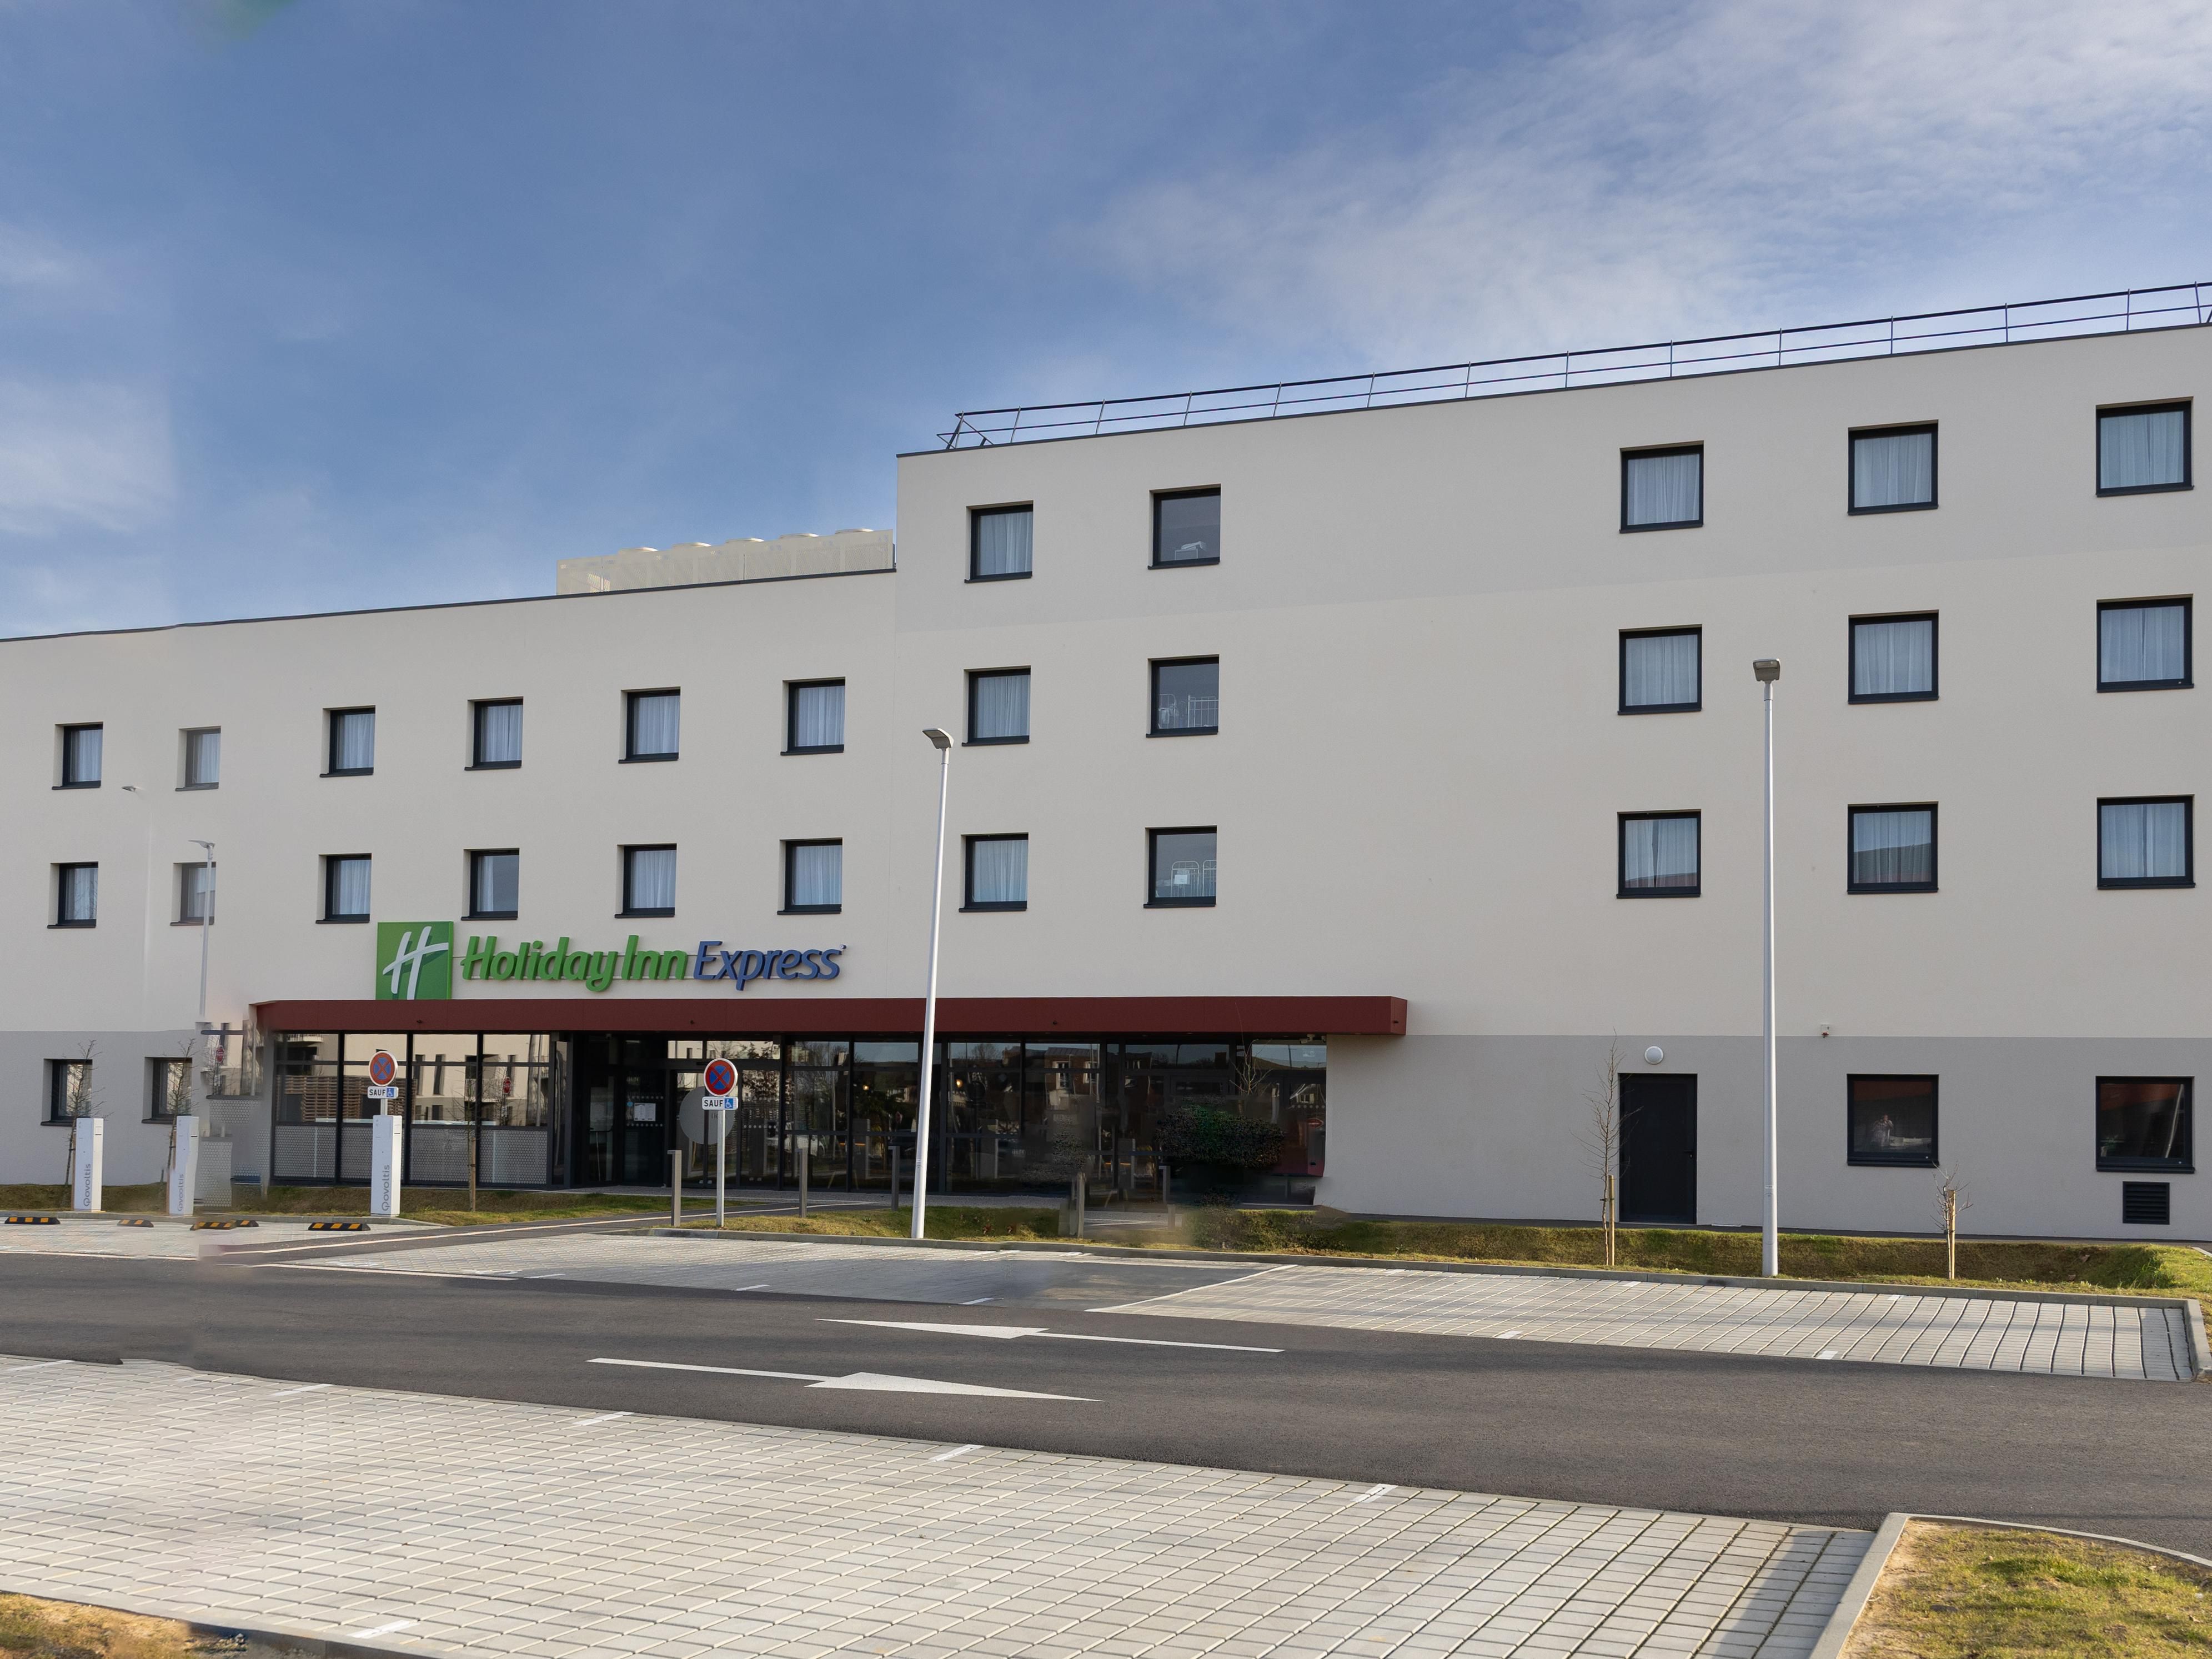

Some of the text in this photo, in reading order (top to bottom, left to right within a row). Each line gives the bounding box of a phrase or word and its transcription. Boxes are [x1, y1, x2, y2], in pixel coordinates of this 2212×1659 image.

[460, 935, 841, 992] Holiday Inn Express
